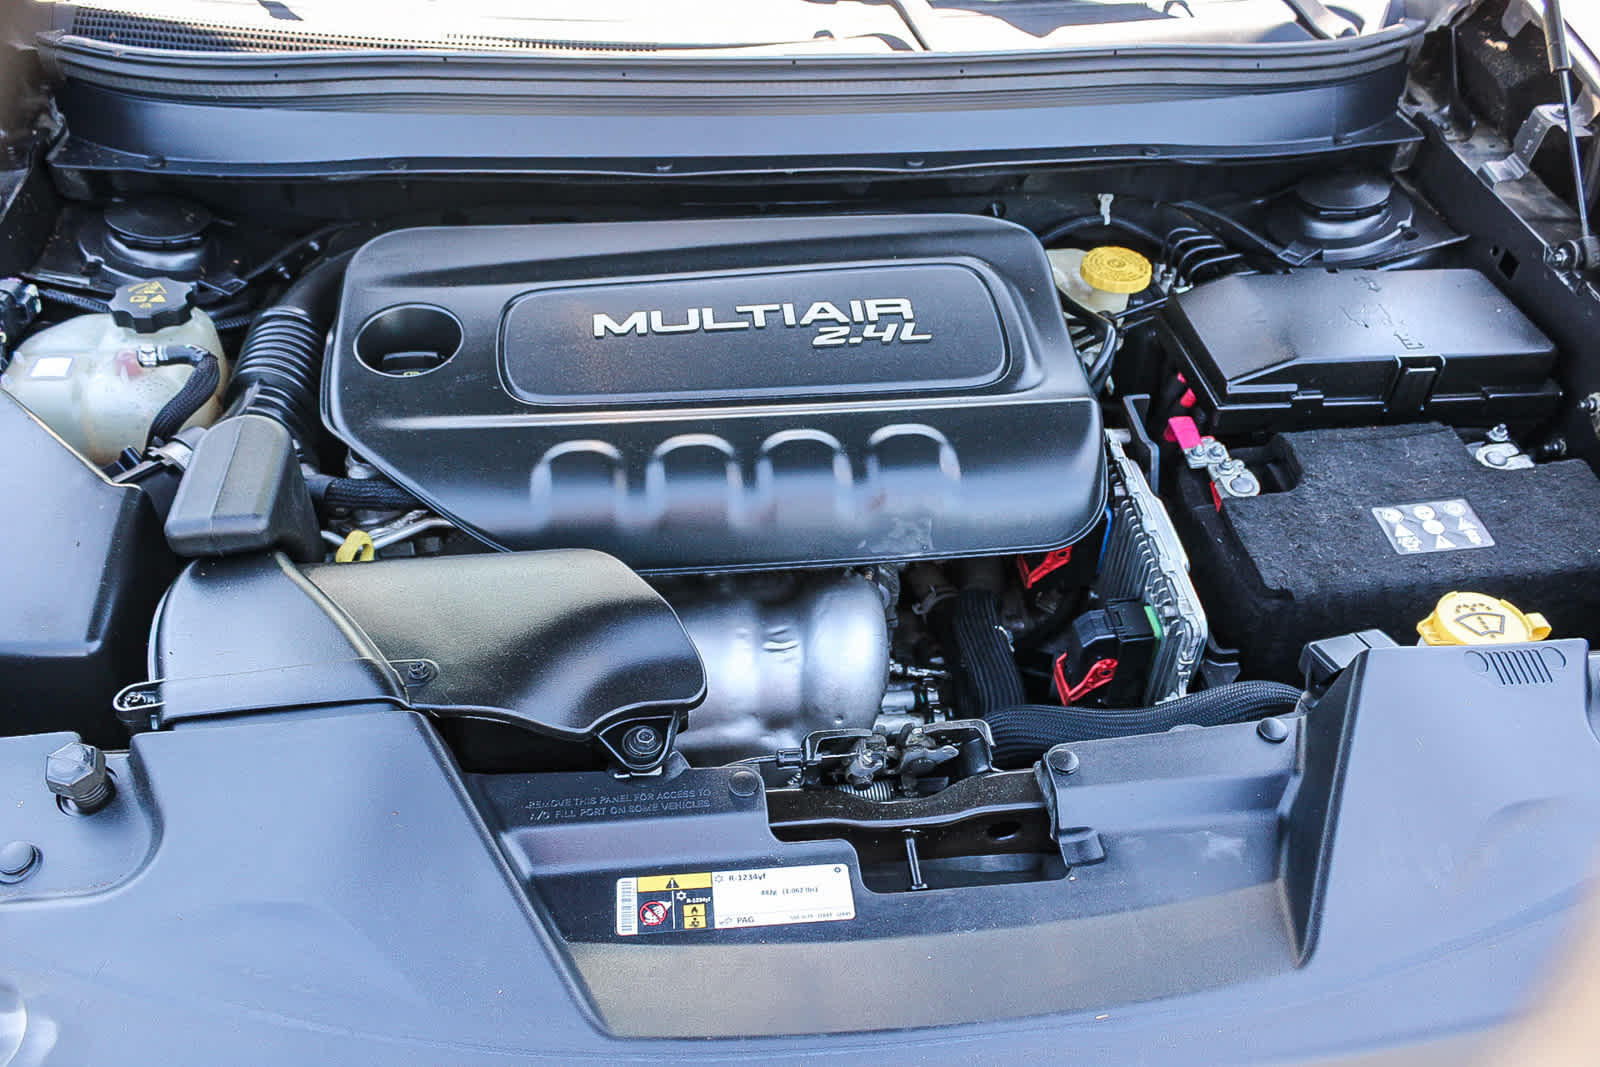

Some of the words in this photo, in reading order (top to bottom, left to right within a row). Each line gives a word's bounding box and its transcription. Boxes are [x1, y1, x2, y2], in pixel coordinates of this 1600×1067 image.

[592, 297, 915, 338] MULTIAIR
[811, 322, 932, 347] 2.4L
[573, 797, 597, 806] THIS
[599, 793, 632, 804] PANEL
[633, 792, 655, 802] FOR
[656, 789, 696, 801] ACCESS
[698, 787, 712, 797] TO
[580, 806, 606, 816] PORT
[610, 805, 626, 815] ON
[661, 799, 712, 810] VEHICLES
[736, 916, 755, 924] PAG
